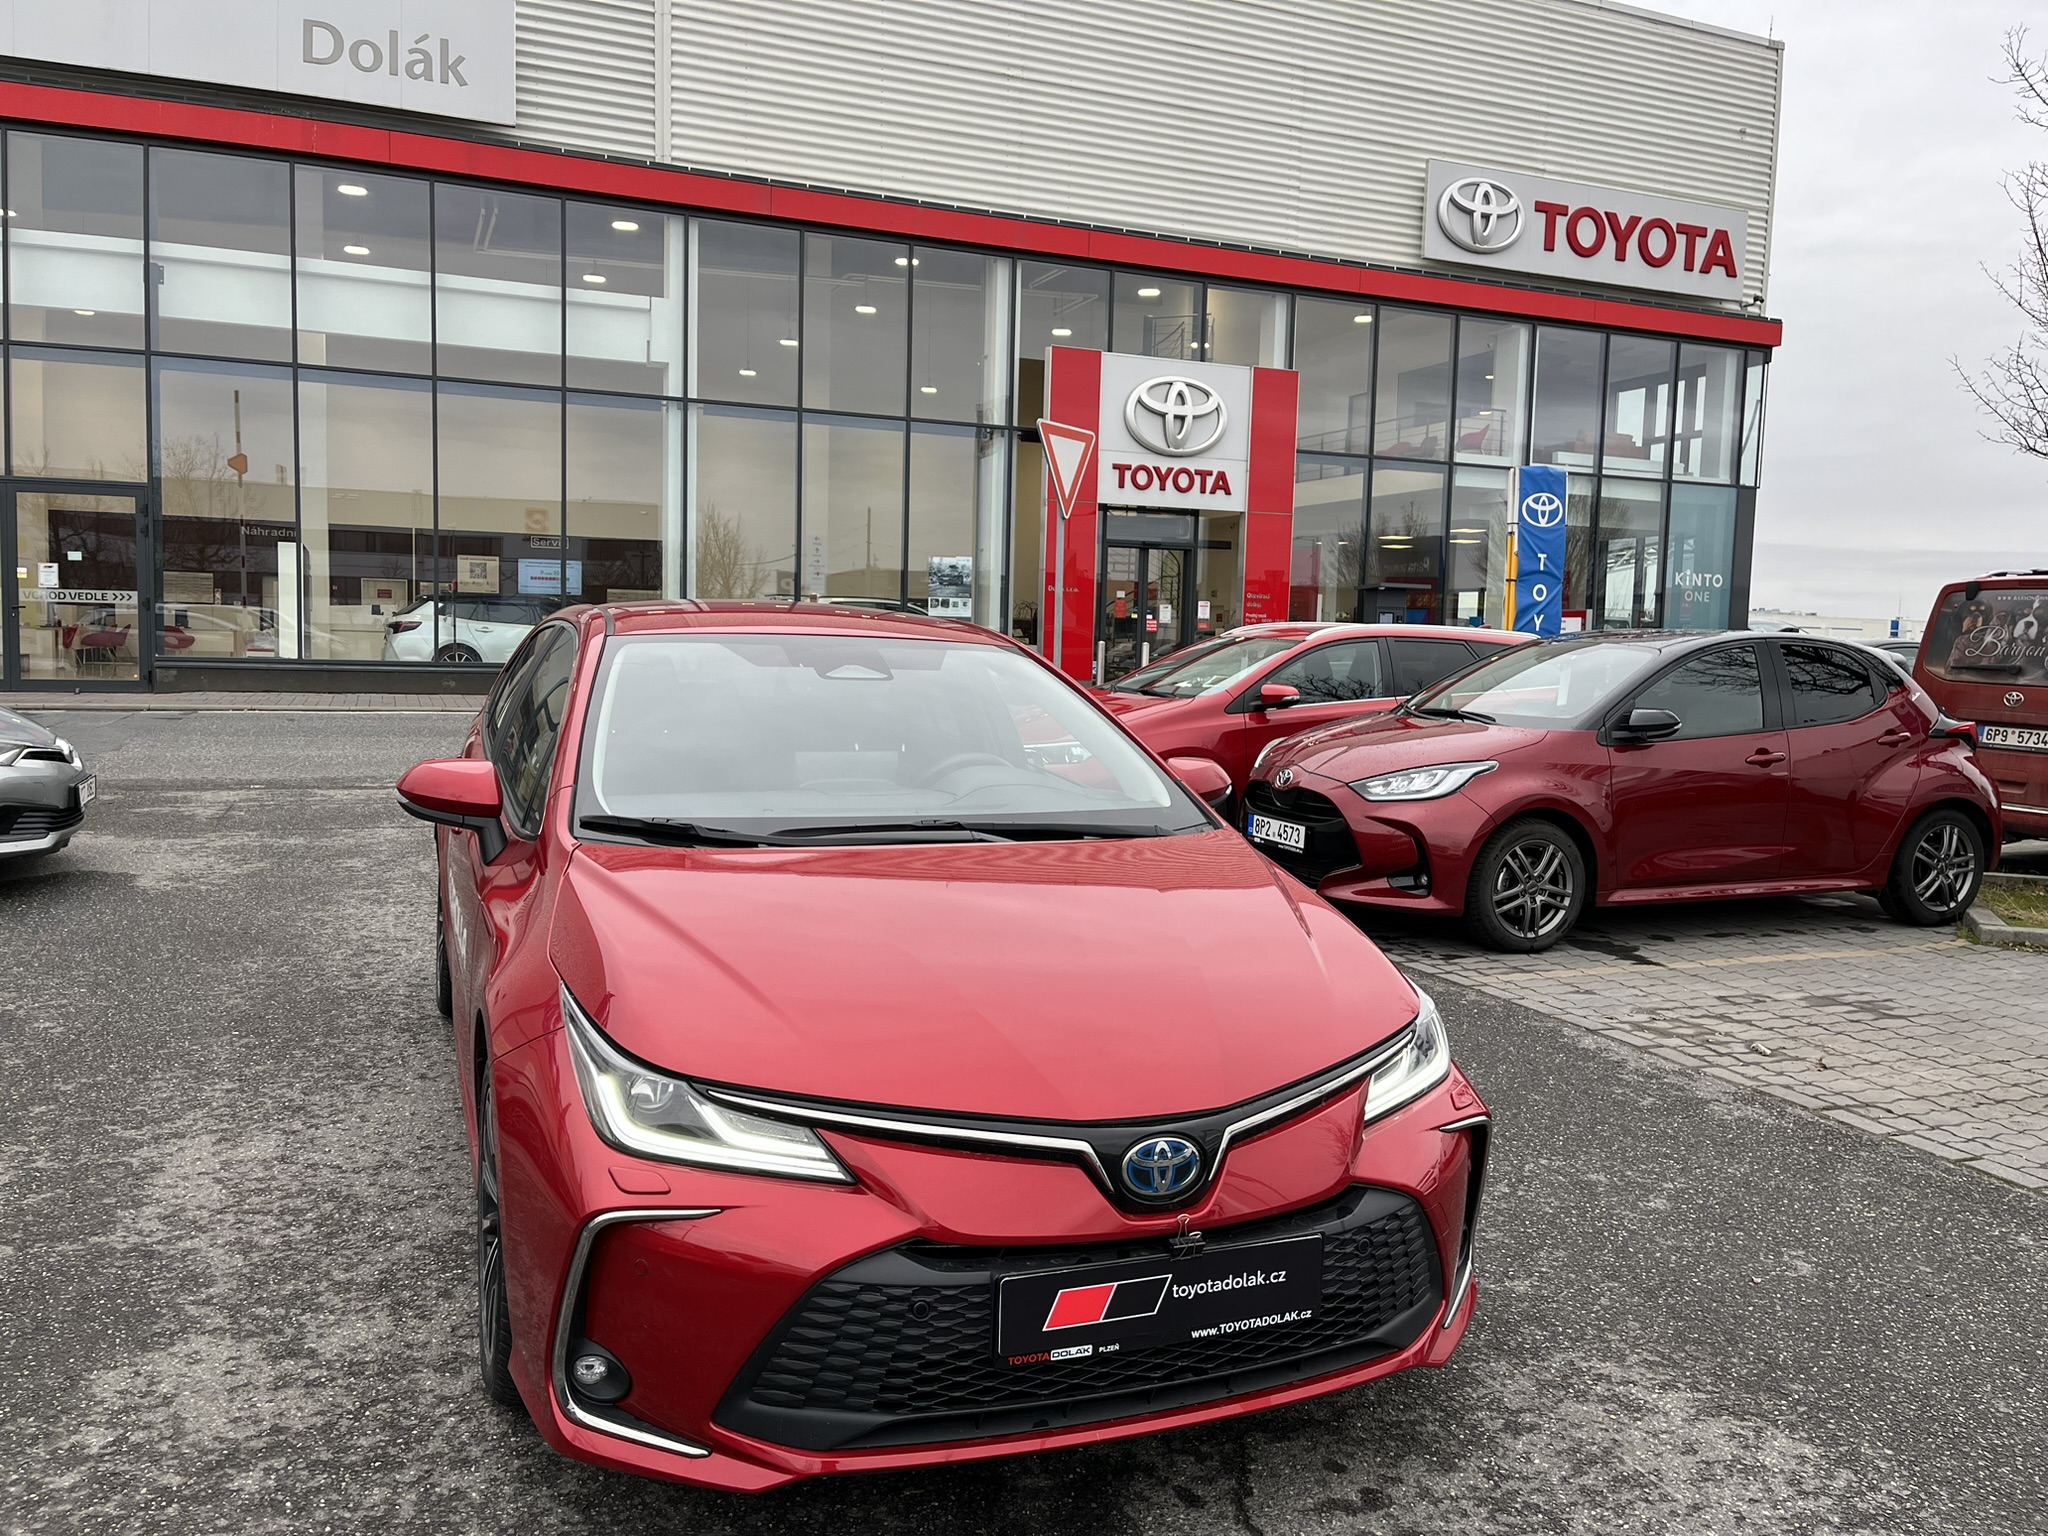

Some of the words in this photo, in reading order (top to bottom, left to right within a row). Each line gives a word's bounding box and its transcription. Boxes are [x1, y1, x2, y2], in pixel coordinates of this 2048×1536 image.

[302, 18, 469, 87] Dolák
[1534, 200, 1738, 278] TOYOTA
[1112, 463, 1232, 495] TOYOTA
[69, 591, 108, 601] VEDLE
[1684, 590, 1710, 603] ONE
[1985, 728, 2009, 743] 6P9
[2017, 730, 2048, 747] 5734
[1255, 818, 1271, 837] 8P2
[1277, 823, 1301, 844] 4573
[1172, 1270, 1287, 1300] toyotadolak.cz
[1191, 1309, 1312, 1339] www.TOYOTADOLAK.cz
[1008, 1352, 1050, 1366] TOYOTA
